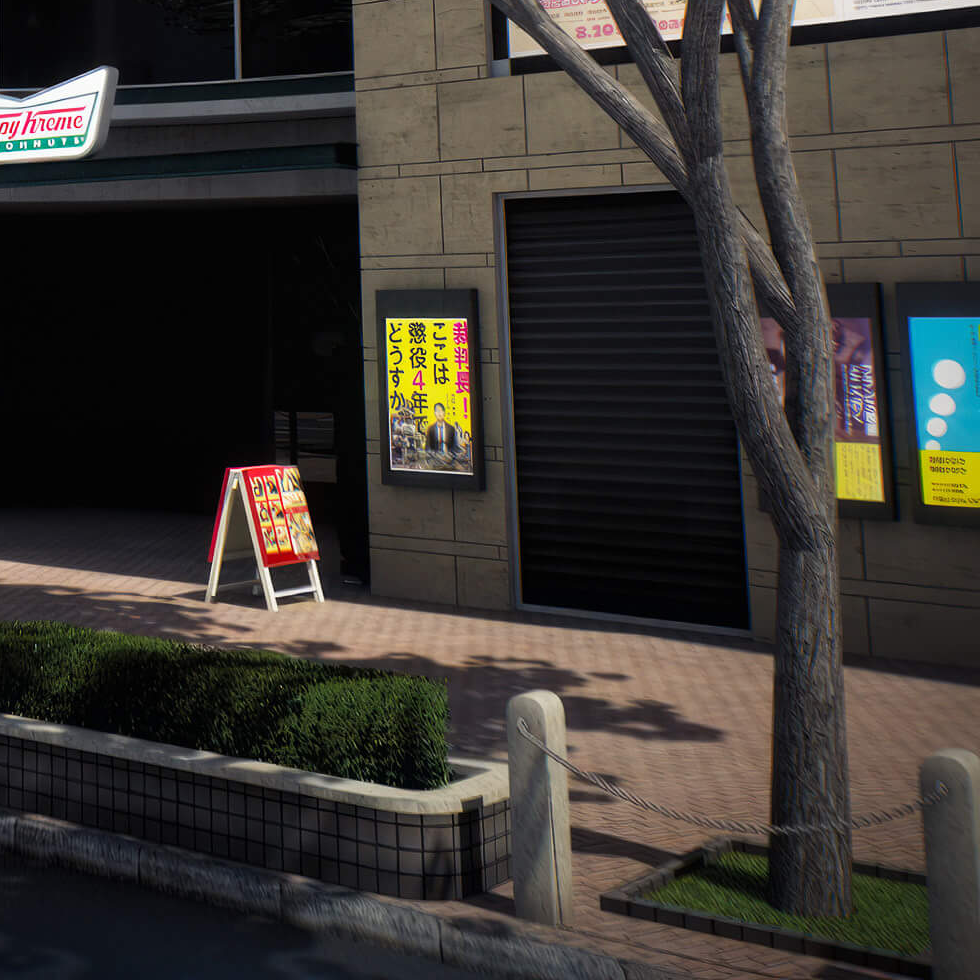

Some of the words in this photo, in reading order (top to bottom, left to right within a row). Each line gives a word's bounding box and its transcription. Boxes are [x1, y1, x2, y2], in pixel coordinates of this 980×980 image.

[21, 106, 86, 135] Kreme
[432, 322, 450, 385] ここは
